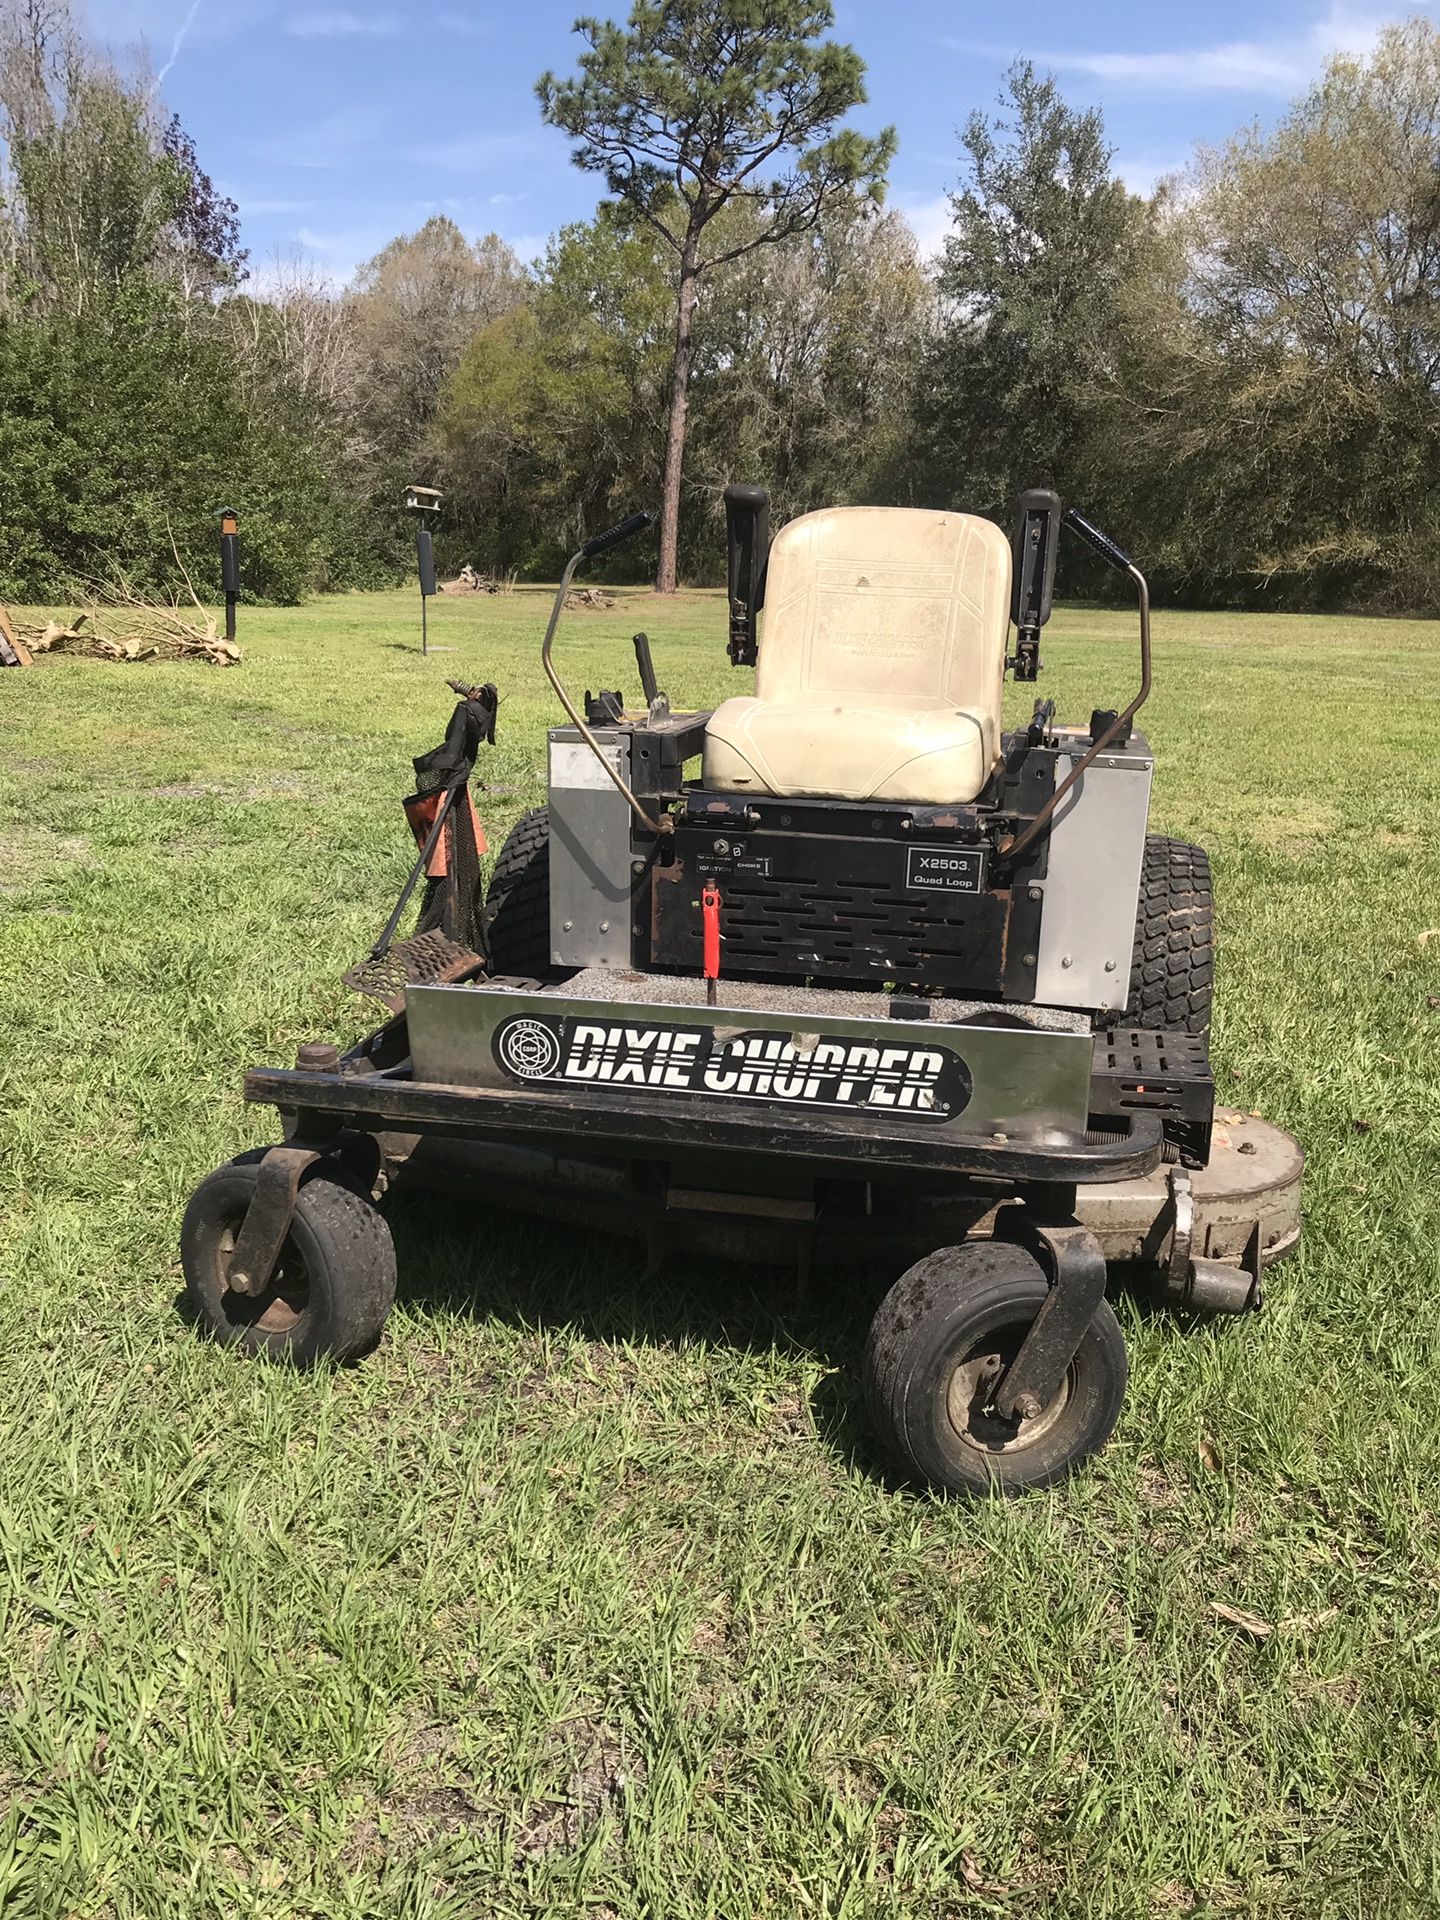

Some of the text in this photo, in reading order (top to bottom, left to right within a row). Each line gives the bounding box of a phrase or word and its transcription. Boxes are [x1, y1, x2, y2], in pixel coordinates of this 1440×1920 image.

[914, 875, 973, 888] Quad Loop
[516, 1022, 542, 1031] MAGIC
[517, 1067, 543, 1077] CIRCLE
[564, 1025, 945, 1109] DIXIE CHOPPER
